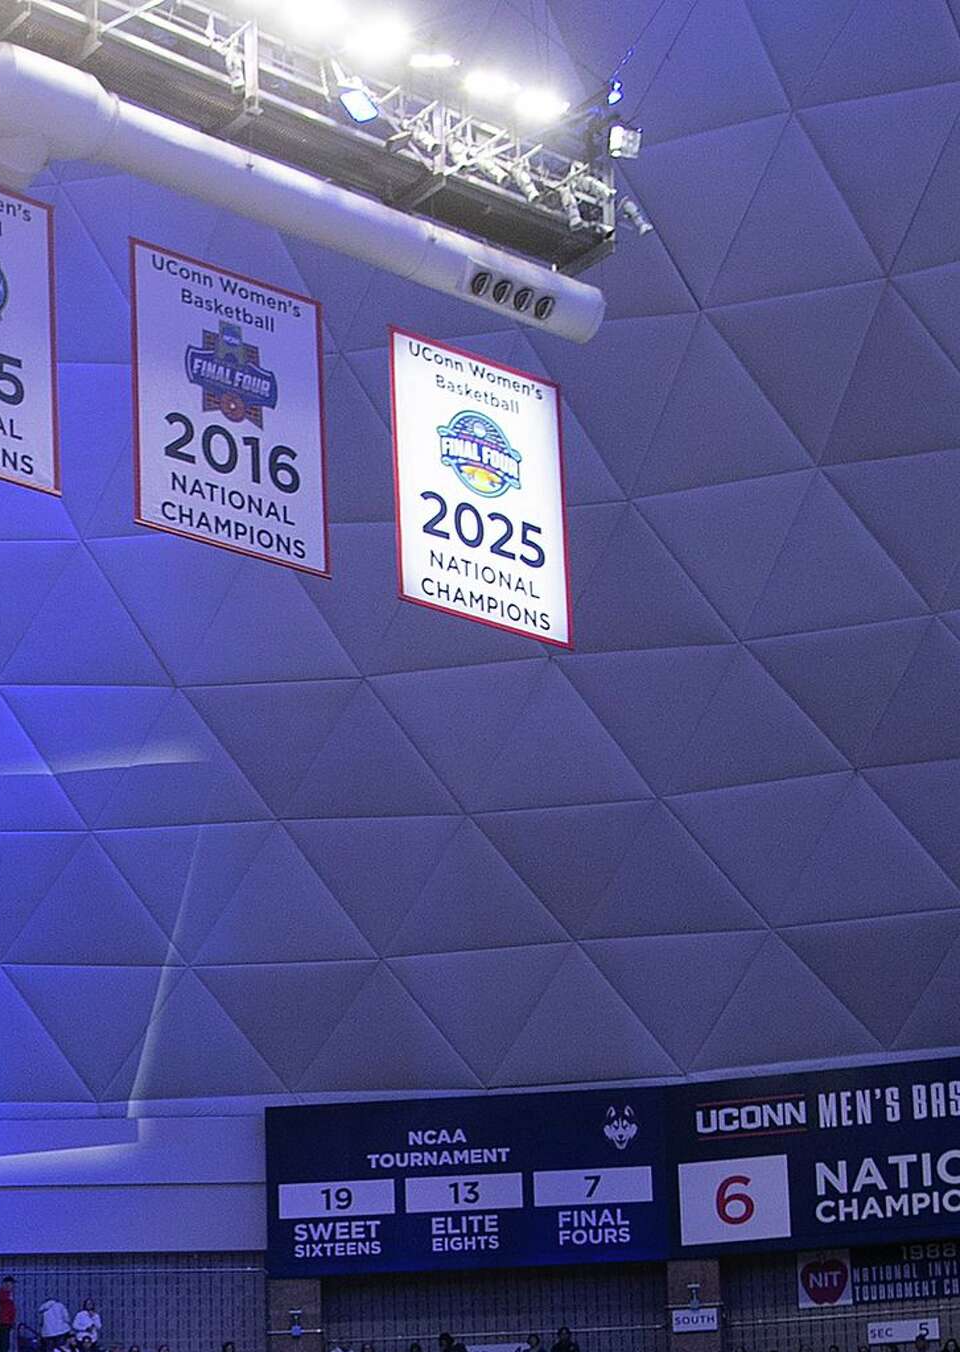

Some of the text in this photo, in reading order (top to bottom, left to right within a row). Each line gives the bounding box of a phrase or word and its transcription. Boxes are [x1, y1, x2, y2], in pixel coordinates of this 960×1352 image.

[152, 254, 301, 318] UConn Women's
[181, 288, 274, 333] Basketball
[192, 358, 271, 398] FINAL FOUR
[408, 341, 543, 400] UConn Women's
[435, 374, 520, 414] Basketball
[164, 412, 301, 494] 2016
[171, 472, 296, 526] NATIONAL
[161, 501, 306, 559] CHAMPIONS
[420, 491, 546, 569] 2025
[430, 550, 541, 599] NATIONAL
[421, 577, 551, 631] CHAMPIONS
[696, 1100, 807, 1134] UCONN
[817, 1086, 900, 1129] MEN'S
[407, 1128, 467, 1145] NCAA
[367, 1147, 510, 1169] TOURNAMENT
[448, 1181, 480, 1205] 13
[583, 1175, 601, 1198] 7
[320, 1187, 353, 1211] 19
[715, 1175, 756, 1226] 6
[431, 1214, 499, 1235] ELITE
[558, 1208, 630, 1228] FINAL
[294, 1220, 381, 1242] SWEET
[558, 1227, 631, 1246] FOURS
[294, 1240, 382, 1258] SIXTEENS
[431, 1235, 500, 1253] EIGHTS
[809, 1270, 840, 1289] NIT
[853, 1263, 918, 1284] NATIONAL
[854, 1280, 937, 1301] TOURNAMENT
[674, 1314, 715, 1326] SOUTH
[870, 1322, 929, 1339] SEC 5
